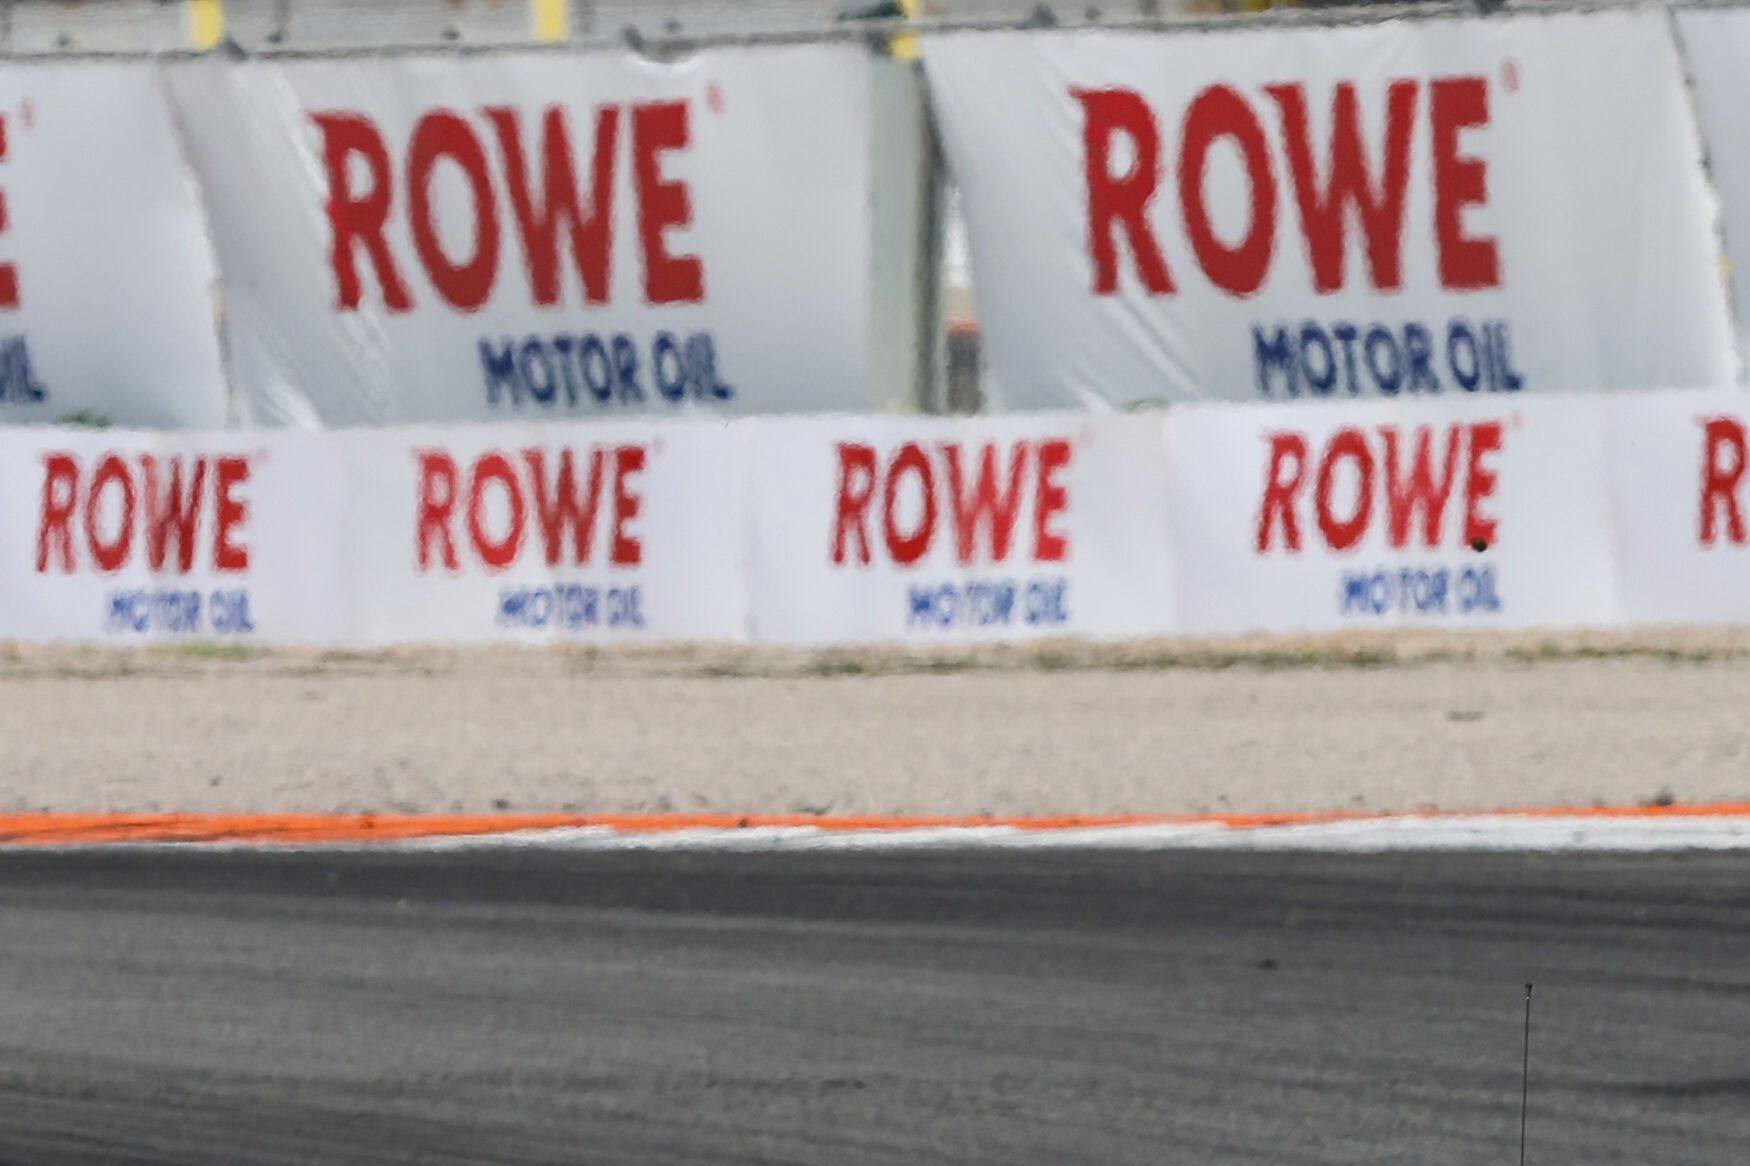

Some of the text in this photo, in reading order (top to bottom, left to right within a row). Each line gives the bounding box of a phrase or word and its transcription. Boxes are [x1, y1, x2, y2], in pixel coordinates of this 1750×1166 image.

[307, 100, 705, 312] ROWE
[1068, 75, 1504, 299] ROWE
[0, 336, 47, 402] IL
[478, 331, 735, 405] MOTOR OIL
[1251, 319, 1524, 395] MOTOR OIL
[36, 455, 251, 573] ROWE
[413, 446, 645, 572] ROWE
[829, 440, 1072, 565] ROWE
[1257, 421, 1504, 553] ROWE
[105, 590, 254, 632] MOTOR OIL
[495, 585, 645, 628] MOTOR OIL
[907, 578, 1069, 626] MOTOR OIL
[1341, 566, 1502, 614] MOTOR OIL
